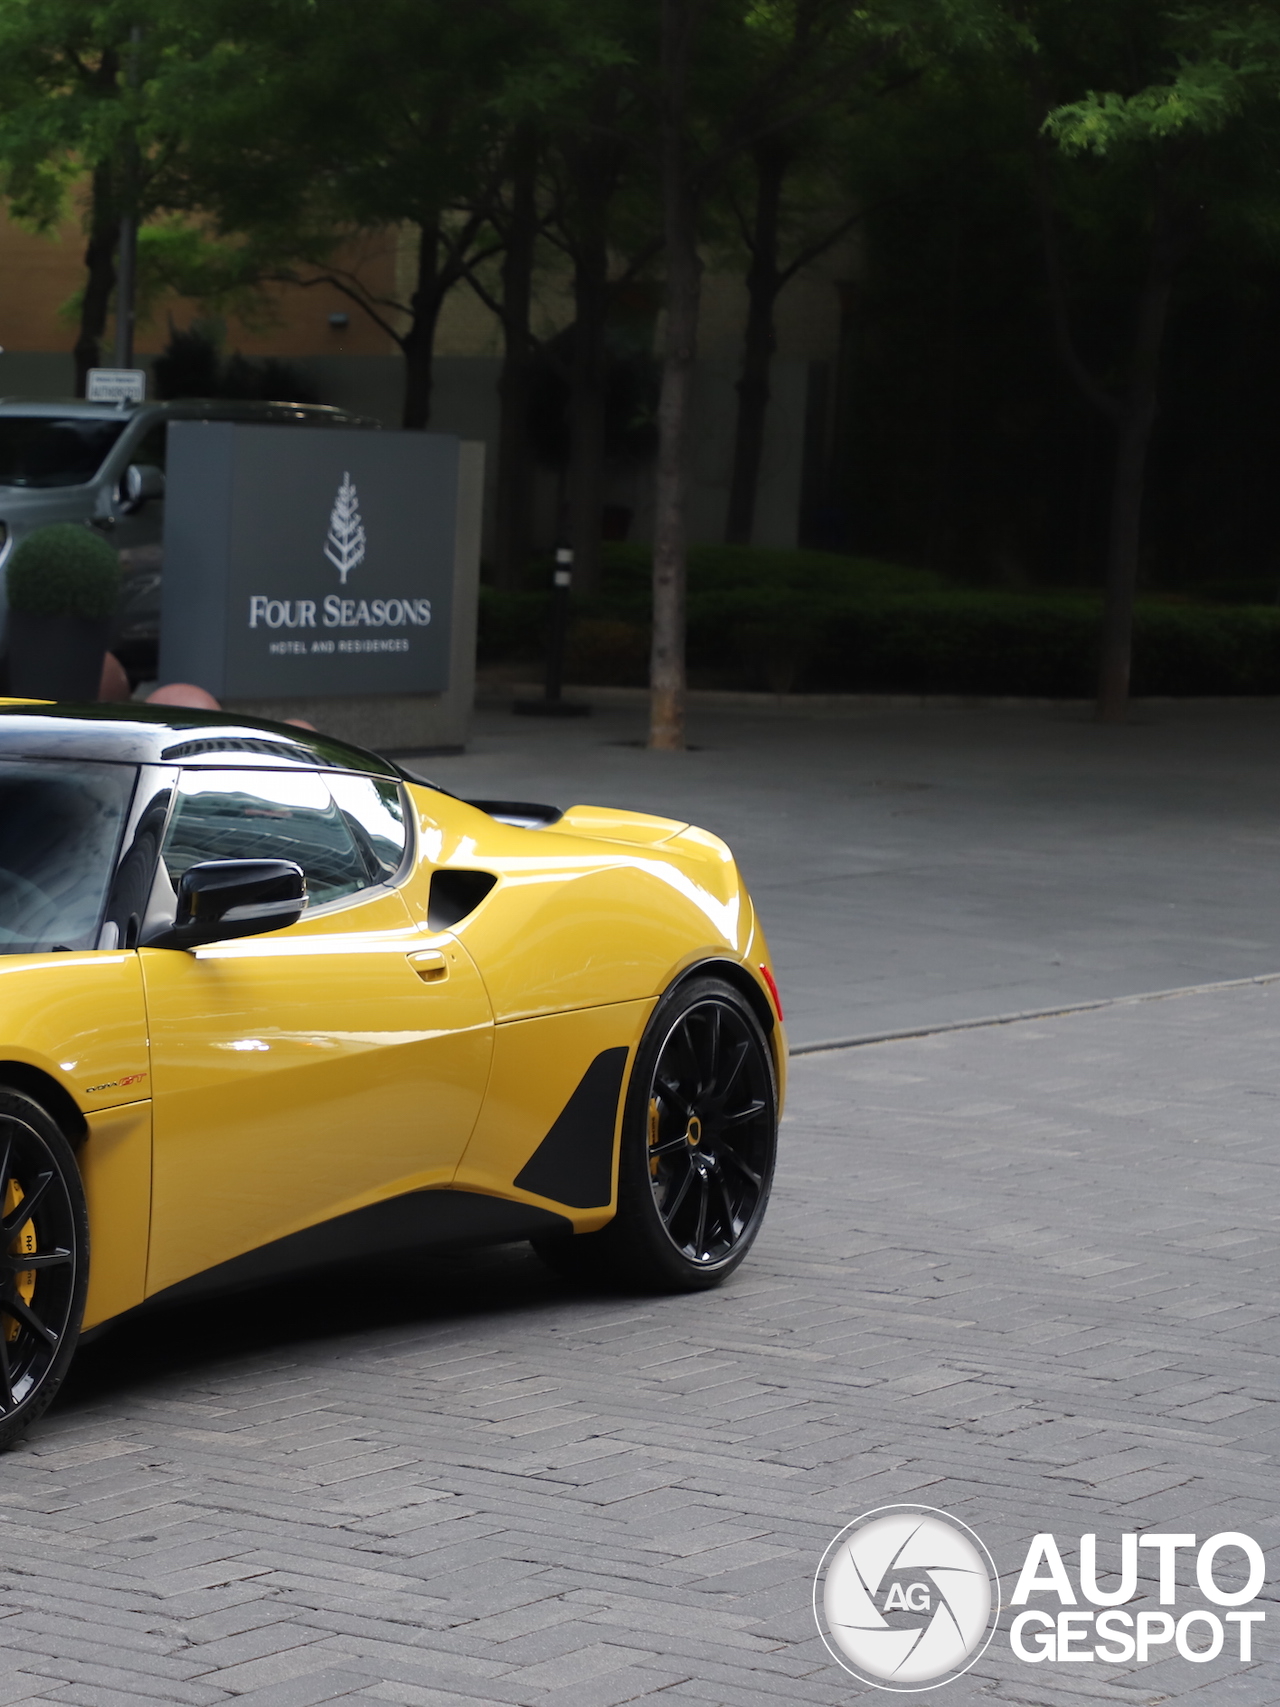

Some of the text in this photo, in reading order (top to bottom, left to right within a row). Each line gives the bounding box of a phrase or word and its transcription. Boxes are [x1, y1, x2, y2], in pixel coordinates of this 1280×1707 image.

[269, 638, 410, 655] HOTEL AND RESIDENCES
